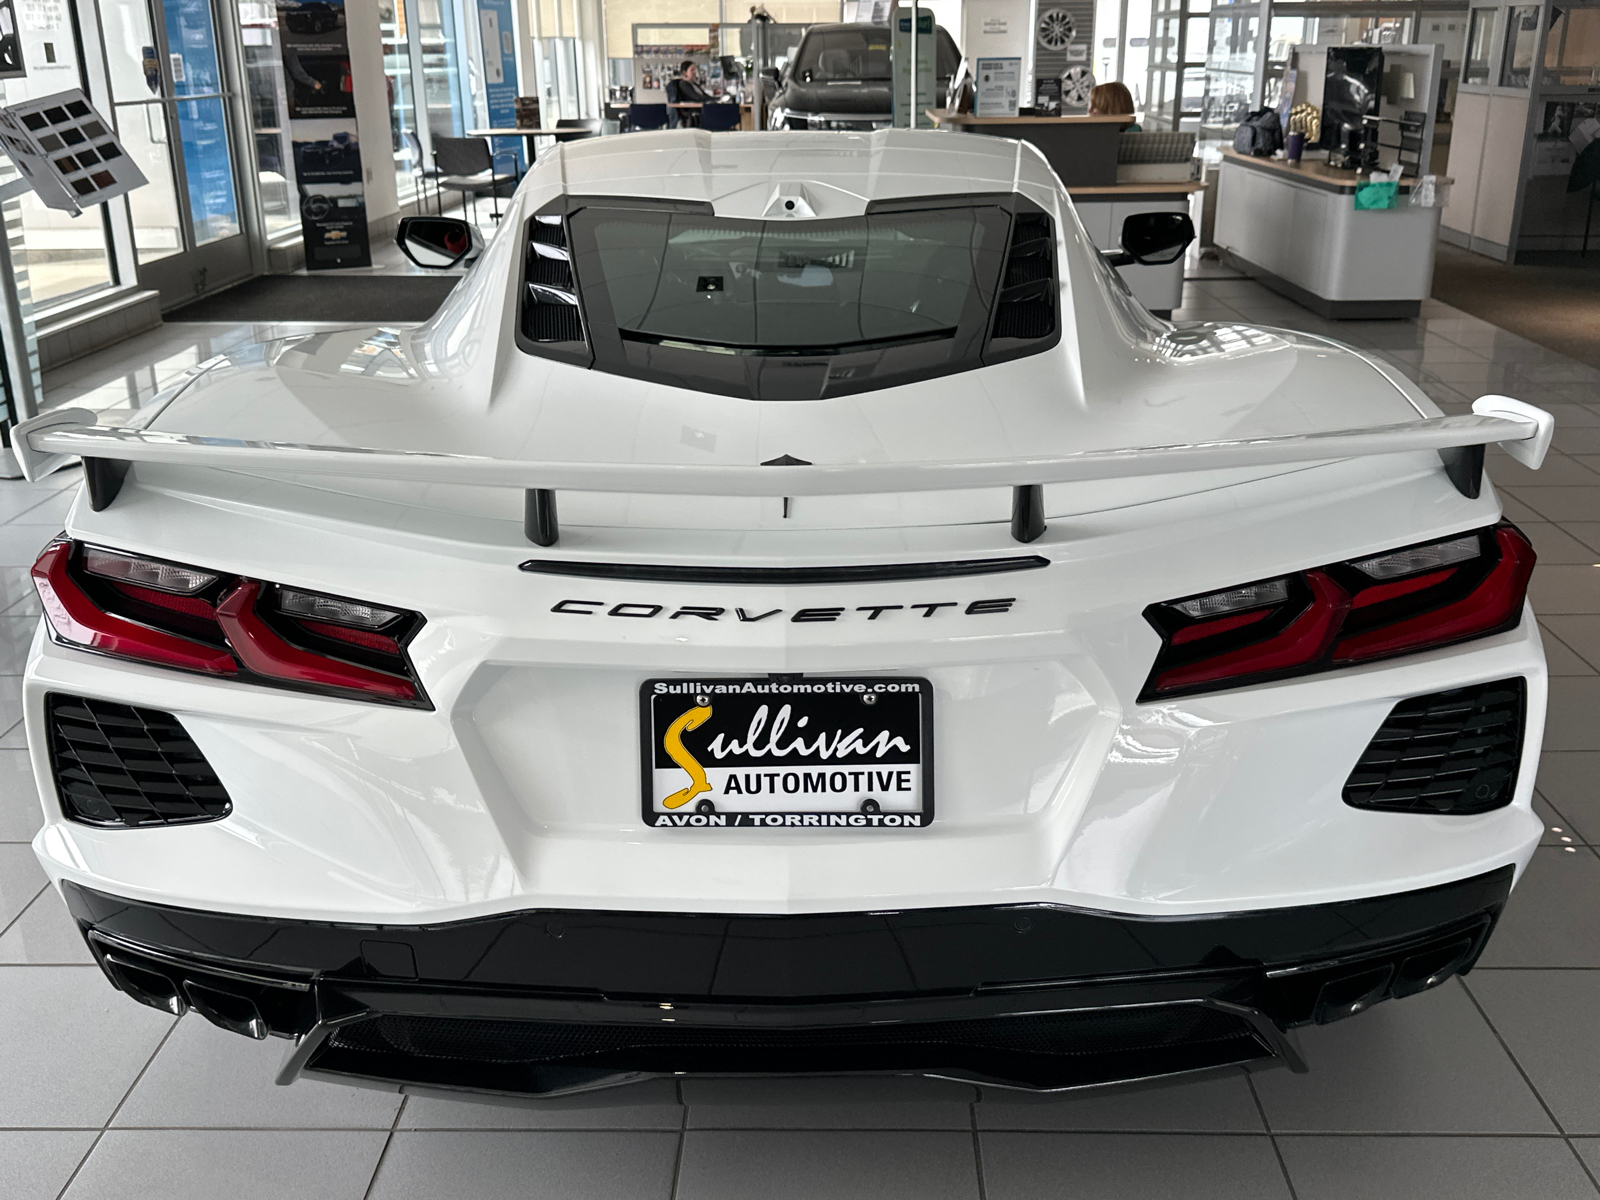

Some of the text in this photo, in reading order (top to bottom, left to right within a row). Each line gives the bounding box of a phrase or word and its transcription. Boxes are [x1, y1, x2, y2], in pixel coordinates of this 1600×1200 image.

[551, 597, 1017, 623] CORVETTE
[654, 682, 920, 694] SullivanAutomotive.com
[662, 704, 911, 809] Sullivan
[723, 771, 912, 795] AUTOMOTIVE
[654, 814, 726, 827] AVON
[747, 814, 921, 827] TORRINGTON
